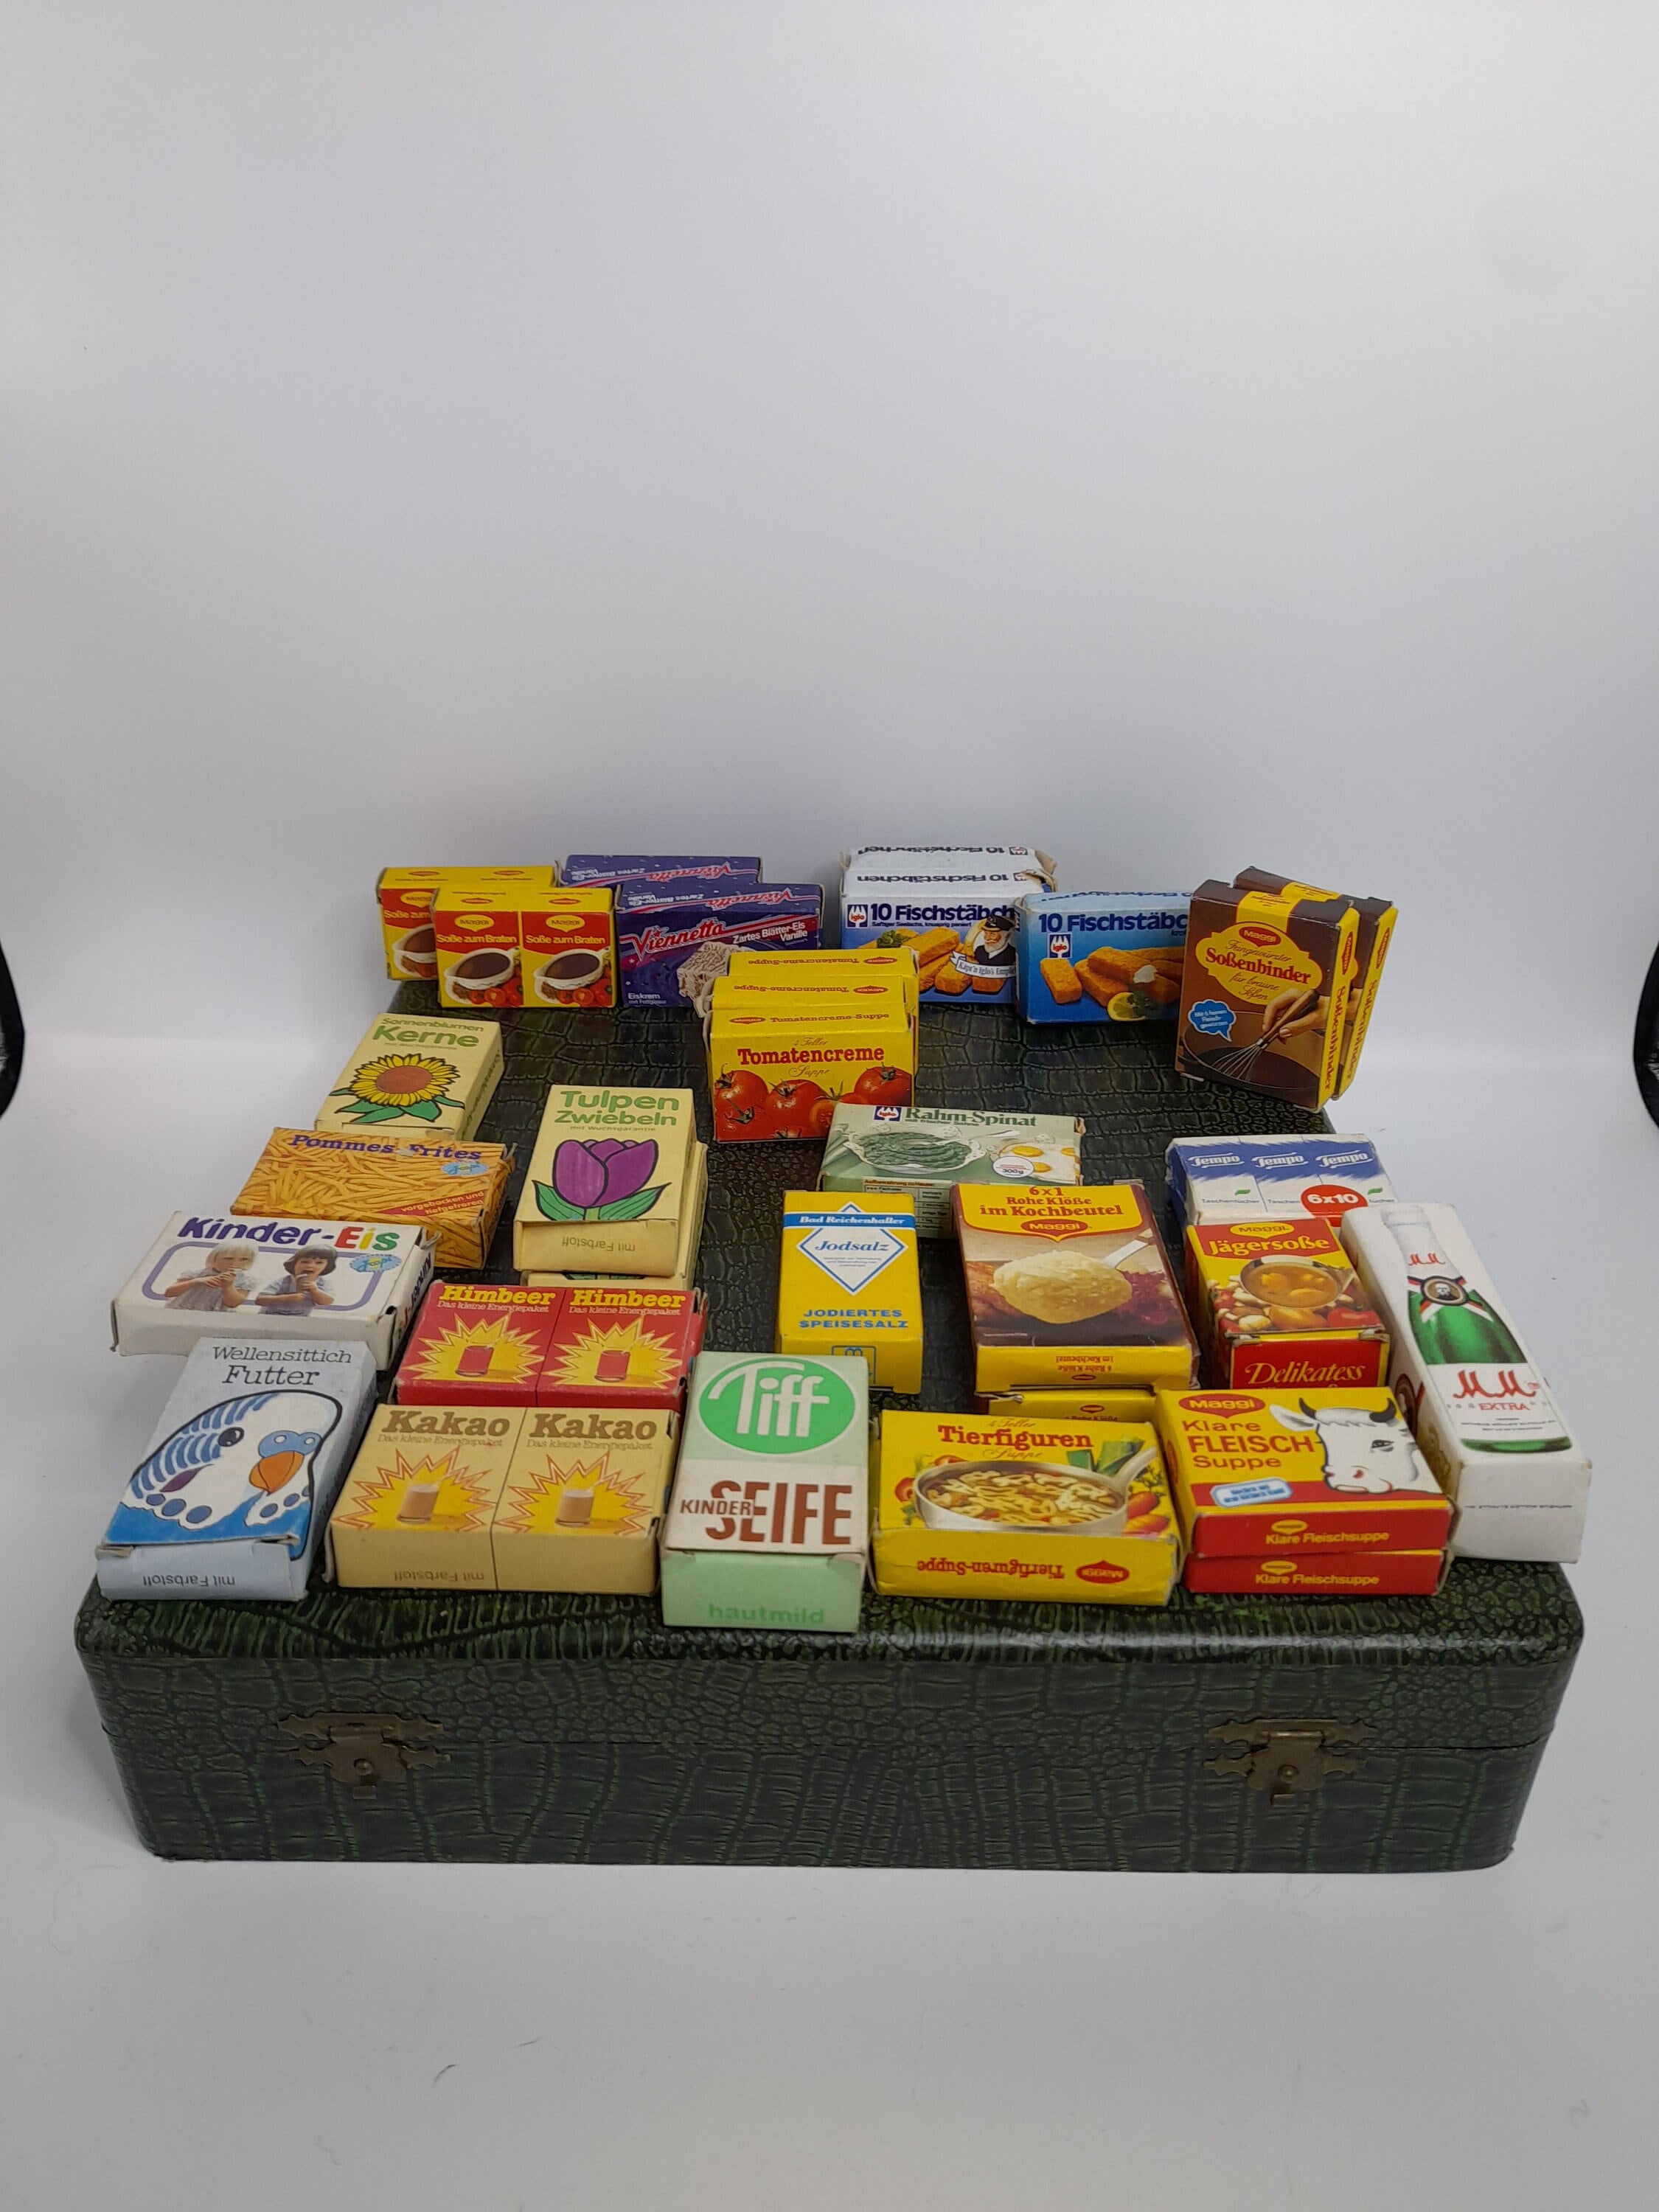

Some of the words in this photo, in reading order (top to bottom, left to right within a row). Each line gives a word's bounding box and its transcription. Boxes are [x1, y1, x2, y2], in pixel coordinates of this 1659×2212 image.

[857, 874, 987, 882] Fischstäbchen
[851, 914, 864, 922] iglo
[871, 904, 892, 920] 10
[896, 904, 1016, 921] Fischstäbch
[1038, 913, 1062, 933] 10
[1067, 912, 1189, 931] Fischstäbc
[437, 935, 462, 943] Soße
[486, 935, 516, 943] Braten
[526, 935, 552, 944] Soße
[553, 936, 574, 944] zum
[574, 935, 605, 944] Braten
[633, 917, 726, 961] Viennetta
[732, 933, 761, 943] Zartes
[761, 922, 806, 939] Blätter-Eis
[780, 931, 808, 942] Vanille
[1242, 929, 1276, 943] Maggi
[1053, 944, 1067, 952] iglo
[1206, 947, 1311, 984] Soßenbinder
[1229, 972, 1246, 983] für
[1246, 976, 1280, 991] braune
[381, 1018, 484, 1032] Sonnenblumen
[770, 1013, 889, 1023] Tomatencreme-Suppe
[372, 1025, 479, 1047] Kerne
[800, 1037, 830, 1047] Teller
[1324, 985, 1346, 1091] Soßenbinder
[737, 1047, 884, 1065] Tomatencreme
[788, 1065, 830, 1077] Suppe
[560, 1090, 679, 1113] Tulpen
[554, 1110, 677, 1126] Zwiebeln
[905, 1108, 1037, 1127] Rahm-Spinat
[291, 1134, 395, 1154] Pommes
[408, 1144, 482, 1160] Frites
[1188, 1152, 1245, 1169] Tempo
[1251, 1152, 1310, 1169] Tempo
[1314, 1150, 1374, 1169] Tempo
[400, 1196, 464, 1213] vorgebacken
[465, 1191, 484, 1200] und
[1006, 1197, 1039, 1205] Rohe
[1040, 1197, 1091, 1205] Klöße
[1307, 1194, 1359, 1204] 6x10
[425, 1200, 484, 1215] tiefgefroren
[980, 1205, 1008, 1215] im
[1012, 1205, 1123, 1217] Kochbeutel
[800, 1216, 824, 1224] Bad
[1029, 1222, 1080, 1231] Maggi
[562, 1236, 614, 1251] Farbstoff
[618, 1242, 636, 1252] mit
[815, 1240, 890, 1251] Jodsalz
[1208, 1235, 1330, 1256] Jägersoße
[439, 1285, 556, 1305] Himbeer
[569, 1289, 686, 1309] Himbeer
[437, 1301, 462, 1310] Das
[464, 1302, 486, 1310] kleine
[487, 1304, 550, 1314] Energiepaket
[568, 1306, 588, 1314] Das
[590, 1307, 616, 1315] kleine
[619, 1307, 681, 1316] Energiepaket
[804, 1309, 902, 1317] JODIERTES
[212, 1346, 352, 1364] Wellensittich
[222, 1365, 320, 1385] Futter
[1245, 1361, 1366, 1385] Delikatess
[708, 1361, 830, 1438] Tiff
[1189, 1399, 1254, 1409] Maggi
[1478, 1402, 1531, 1411] EXTRA
[381, 1410, 510, 1437] Kakao
[529, 1413, 658, 1441] Kakao
[997, 1418, 1036, 1428] Teller
[1182, 1420, 1262, 1432] Klare
[377, 1434, 398, 1443] Das
[400, 1435, 432, 1444] kleine
[526, 1439, 547, 1447] Das
[549, 1440, 581, 1449] kleine
[938, 1425, 1093, 1451] Tierfiguren
[1188, 1435, 1315, 1453] FLEISCH
[982, 1447, 1043, 1460] Suppe
[1194, 1455, 1281, 1470] Suppe
[681, 1499, 753, 1516] KINDER
[706, 1480, 852, 1545] SEIFE
[1265, 1534, 1300, 1545] Klare
[1303, 1531, 1390, 1544] Fleischsuppe
[917, 1557, 1065, 1579] Tierfiguren-Suppe
[143, 1575, 209, 1586] Farbstoff
[212, 1575, 235, 1585] mit
[394, 1571, 458, 1581] Farbstoff
[462, 1572, 484, 1582] mit
[1256, 1575, 1290, 1585] Klare
[1293, 1574, 1380, 1586] Fleischsuppe
[709, 1604, 825, 1624] hautmild
